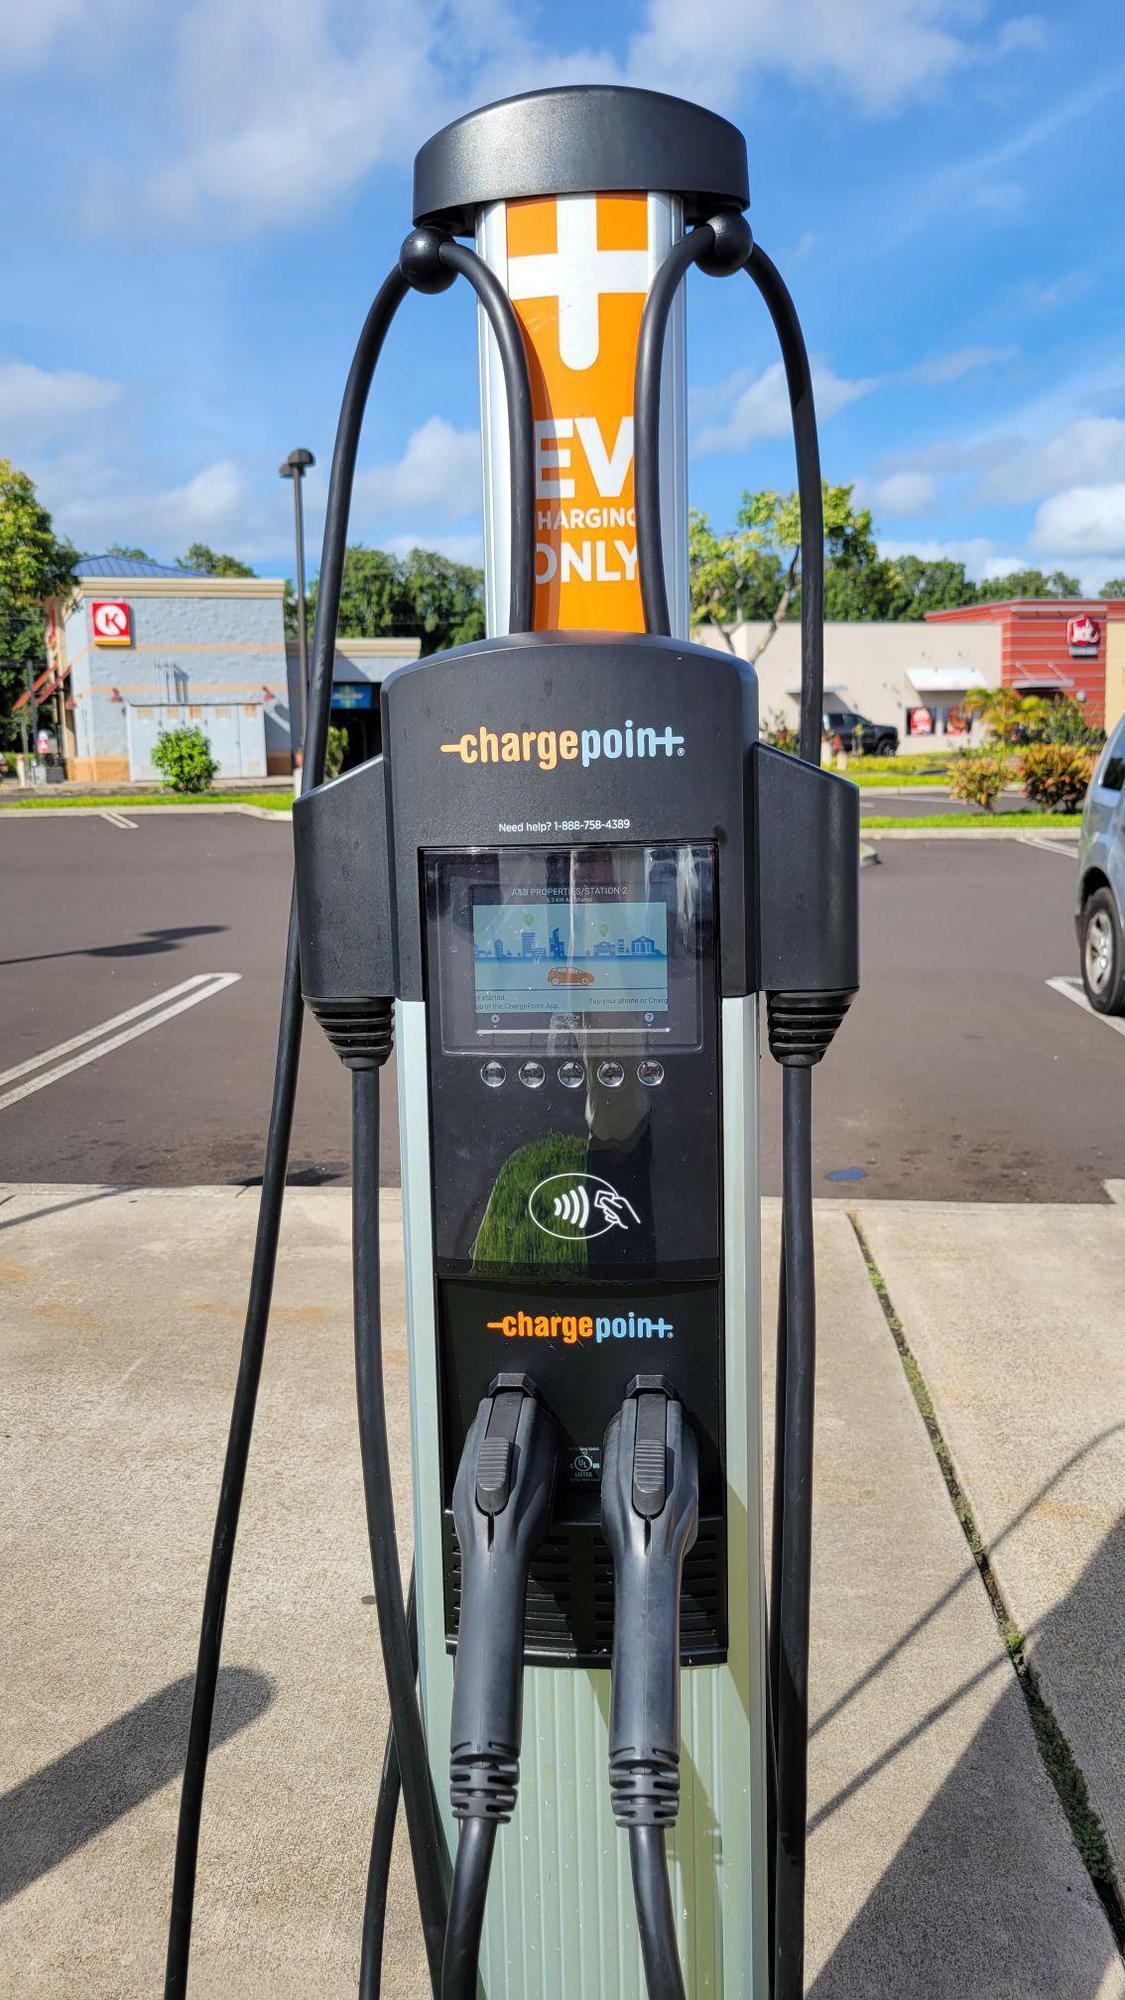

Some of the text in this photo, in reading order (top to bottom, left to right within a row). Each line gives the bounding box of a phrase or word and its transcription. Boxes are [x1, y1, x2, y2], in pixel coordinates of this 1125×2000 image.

[534, 416, 635, 499] EV
[537, 506, 636, 530] HARGIN
[498, 819, 630, 833] Need help? 1-888-758-4389
